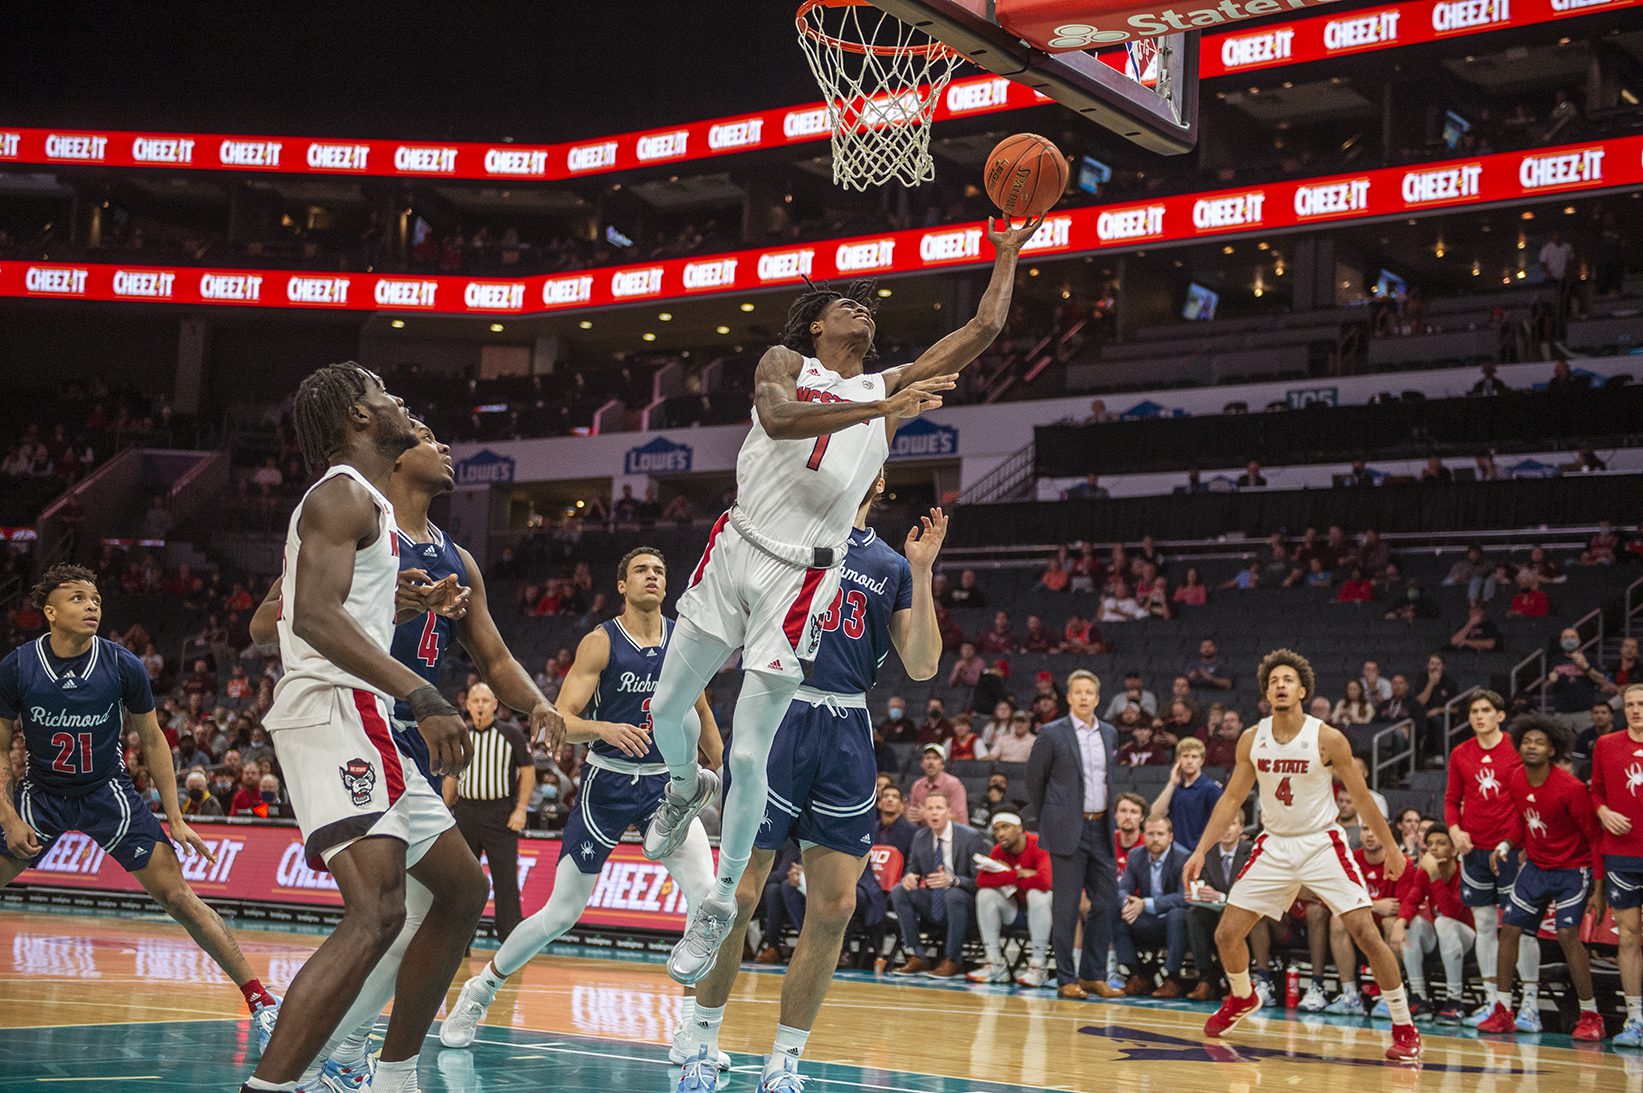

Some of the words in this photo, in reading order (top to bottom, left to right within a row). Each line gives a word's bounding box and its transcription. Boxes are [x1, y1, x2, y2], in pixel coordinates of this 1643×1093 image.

[1127, 0, 1282, 36] State
[840, 560, 889, 595] hmond
[417, 610, 440, 667] 4
[616, 671, 659, 693] Rich
[30, 702, 114, 727] Richmond
[51, 731, 94, 774] 21
[1272, 758, 1310, 774] STATE
[1275, 776, 1294, 806] 4
